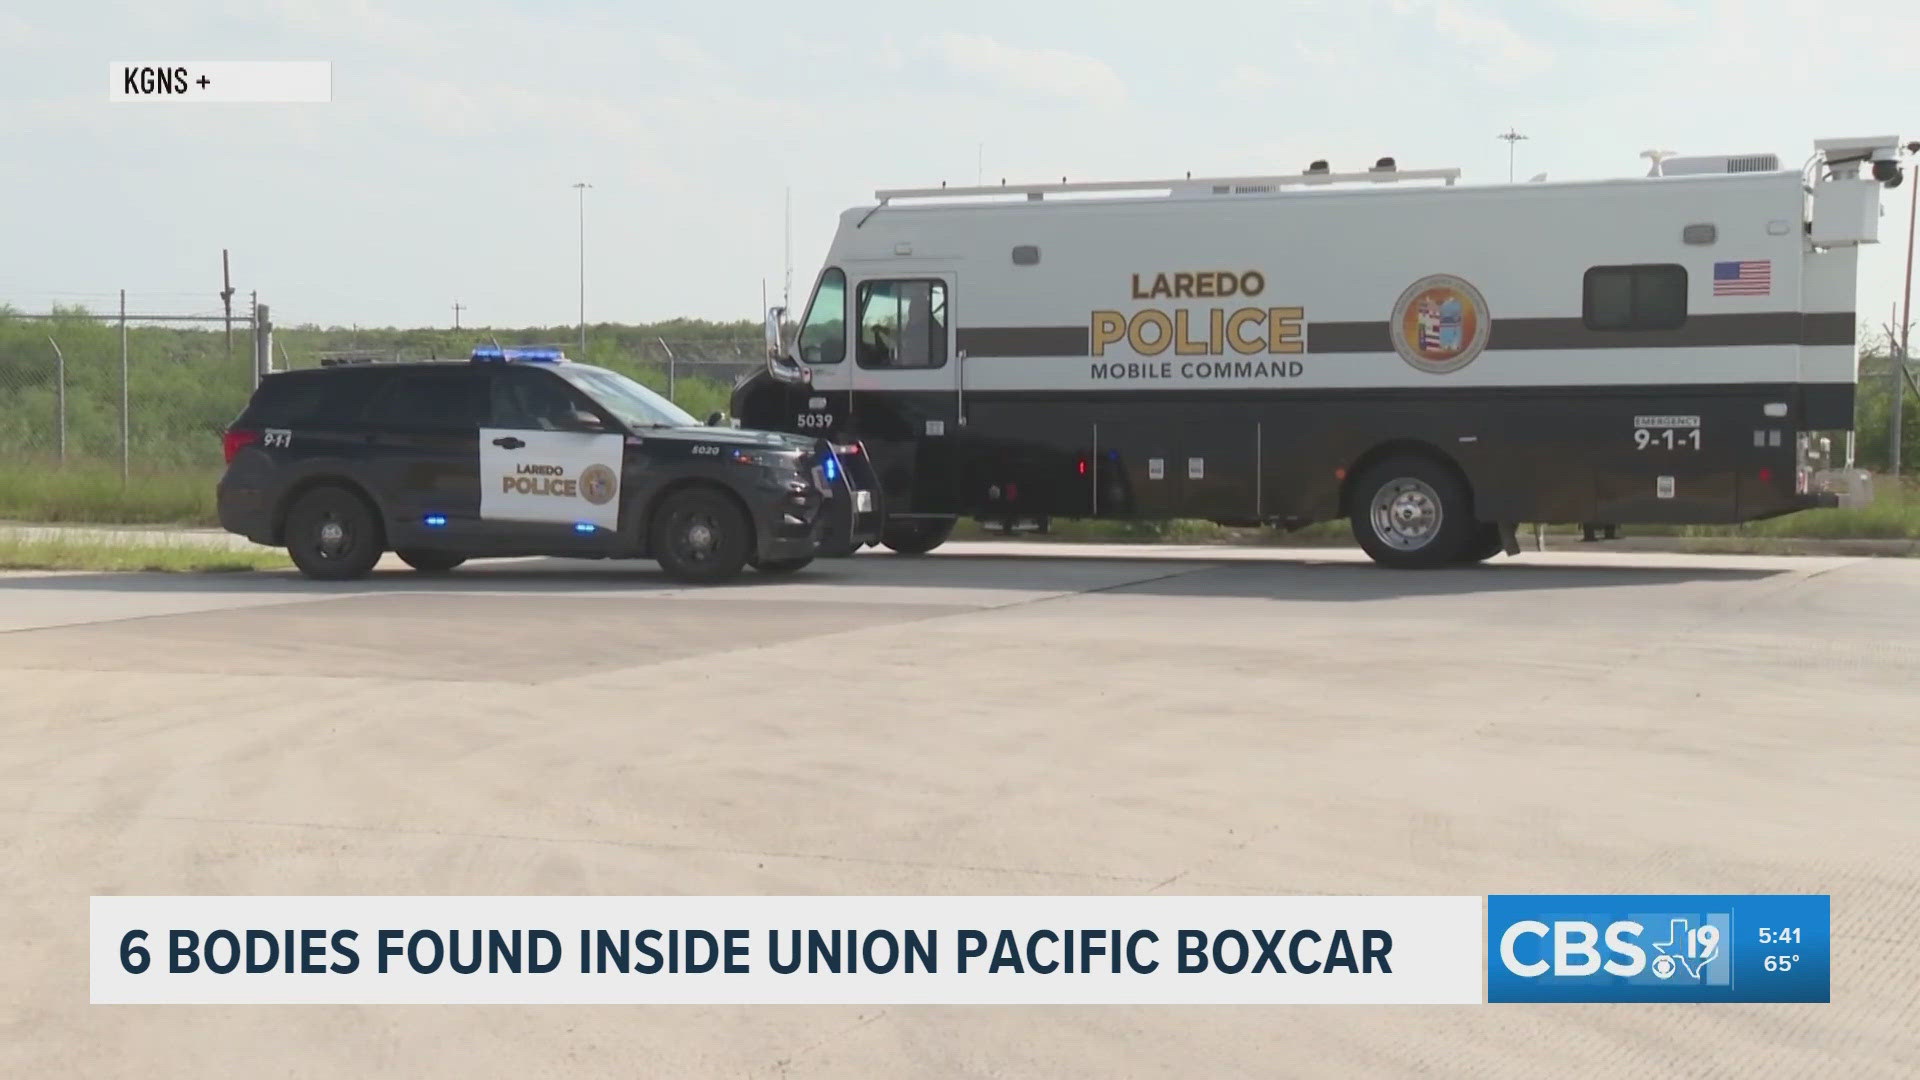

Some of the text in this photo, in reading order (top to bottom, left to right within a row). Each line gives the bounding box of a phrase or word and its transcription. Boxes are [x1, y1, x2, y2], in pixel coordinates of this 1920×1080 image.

[1131, 270, 1266, 299] LAREDO
[1091, 306, 1304, 357] POLICE
[1091, 361, 1304, 379] MOBILE COMMAND
[797, 414, 833, 428] 5039
[1634, 416, 1700, 427] EMERGENCY
[1634, 429, 1700, 450] 9-1-1
[516, 463, 564, 476] LAREDO
[503, 477, 577, 497] POLICE
